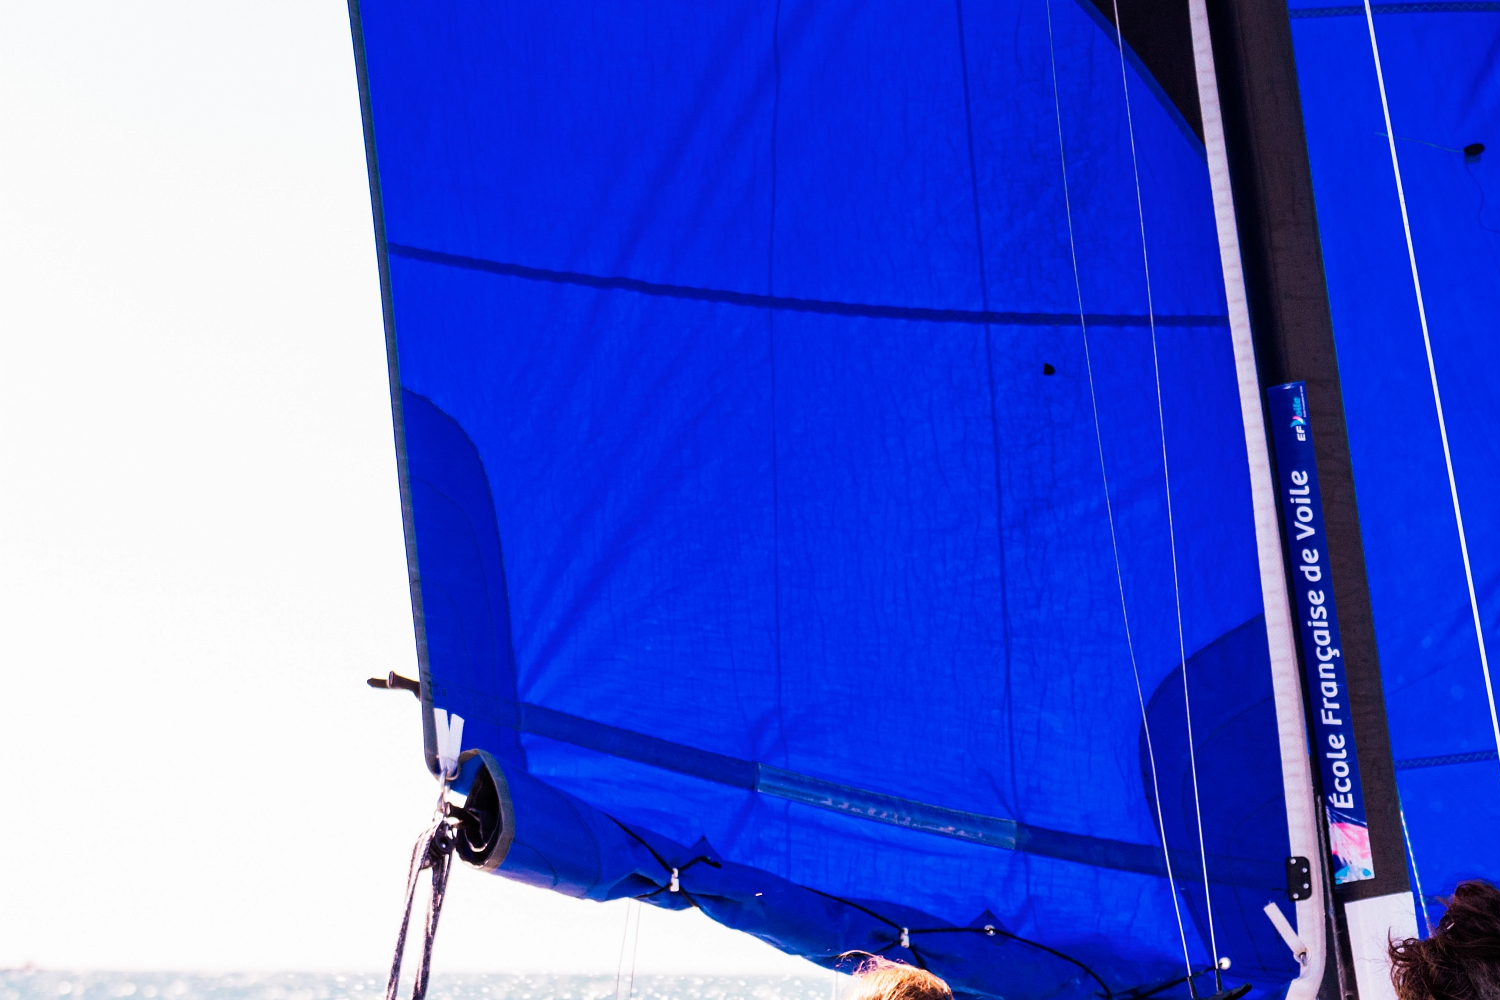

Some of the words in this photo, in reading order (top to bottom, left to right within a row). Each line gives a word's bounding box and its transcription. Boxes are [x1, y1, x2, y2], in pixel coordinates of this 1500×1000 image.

[1289, 470, 1316, 541] Voile
[1300, 549, 1323, 582] de
[1307, 590, 1342, 725] Française
[1326, 734, 1354, 808] École
